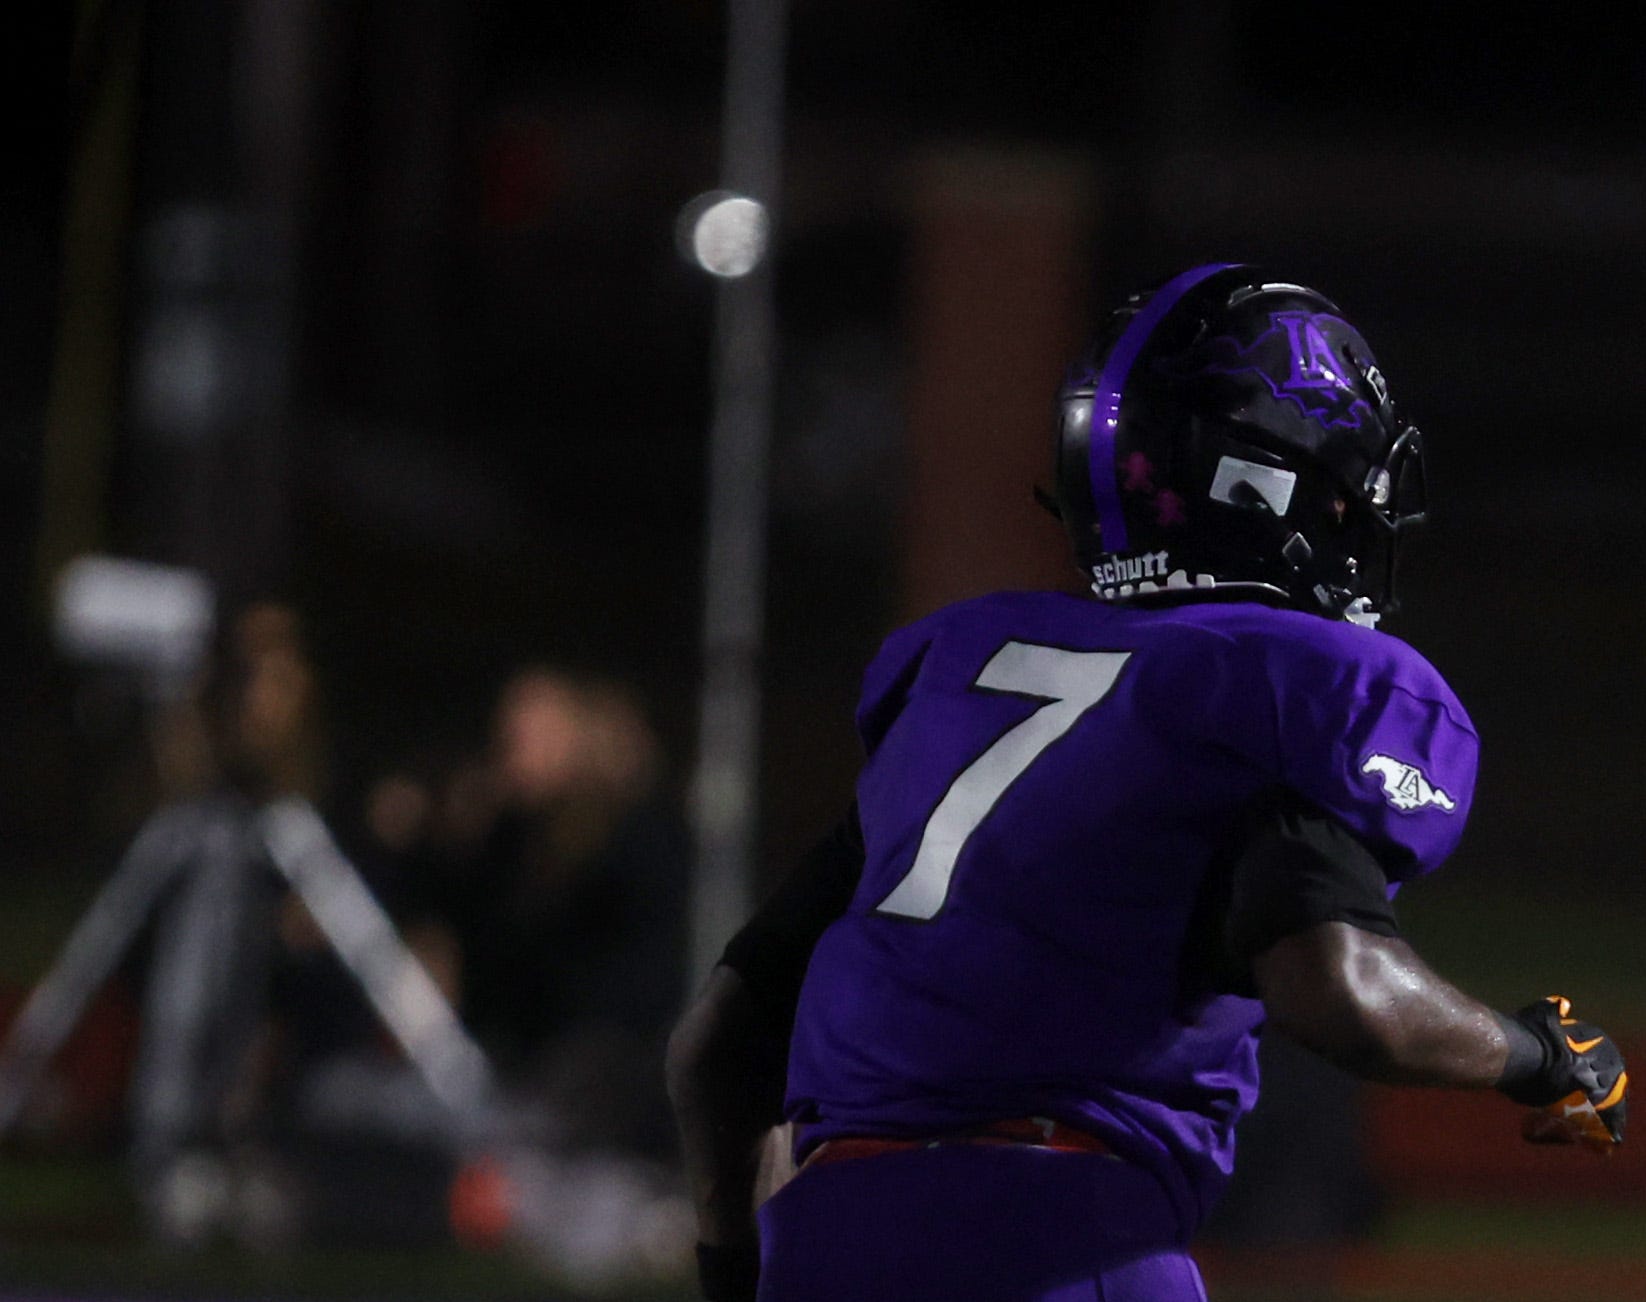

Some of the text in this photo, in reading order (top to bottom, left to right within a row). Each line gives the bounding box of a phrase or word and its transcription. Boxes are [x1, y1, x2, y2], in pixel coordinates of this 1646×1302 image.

[1092, 550, 1168, 584] schutt
[875, 640, 1132, 921] 7
[1394, 767, 1422, 804] LA
